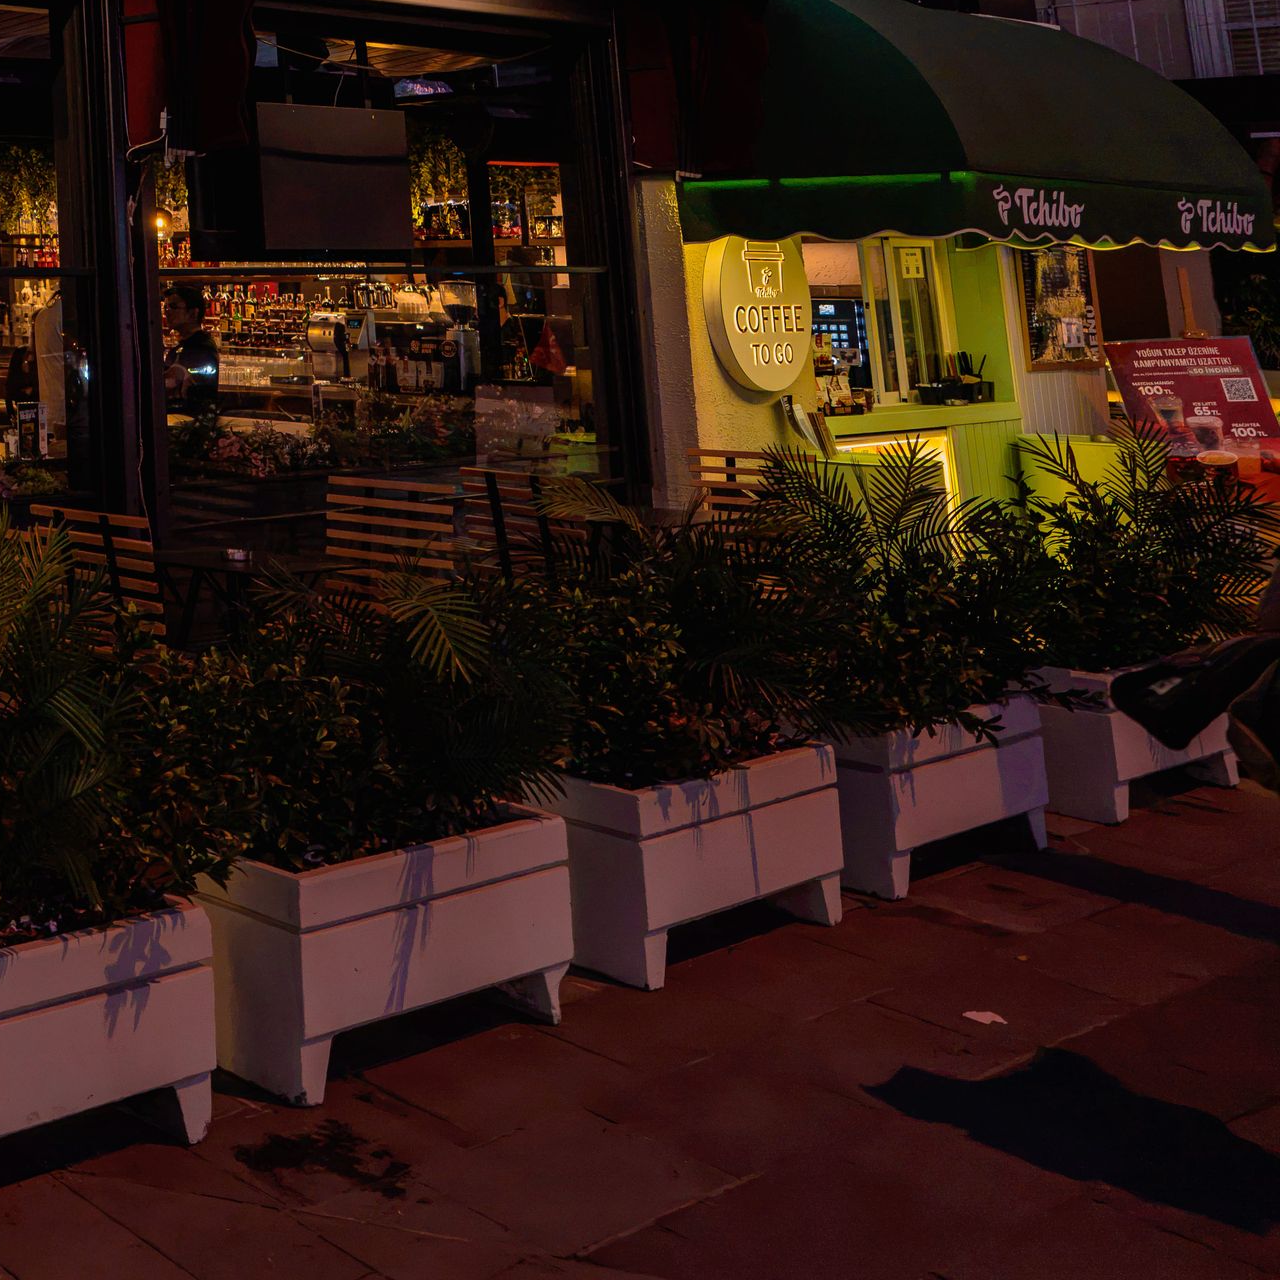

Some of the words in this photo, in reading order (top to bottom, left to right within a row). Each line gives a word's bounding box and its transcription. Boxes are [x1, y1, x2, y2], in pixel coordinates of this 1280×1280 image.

[1014, 188, 1085, 228] Tchibo
[1196, 199, 1255, 235] Tchibo
[734, 305, 805, 334] COFFEE
[751, 343, 770, 366] TO
[774, 342, 794, 365] GO
[1163, 348, 1186, 356] TALEP
[1138, 386, 1163, 395] 100
[1194, 407, 1210, 415] 65
[1230, 427, 1256, 437] 100
